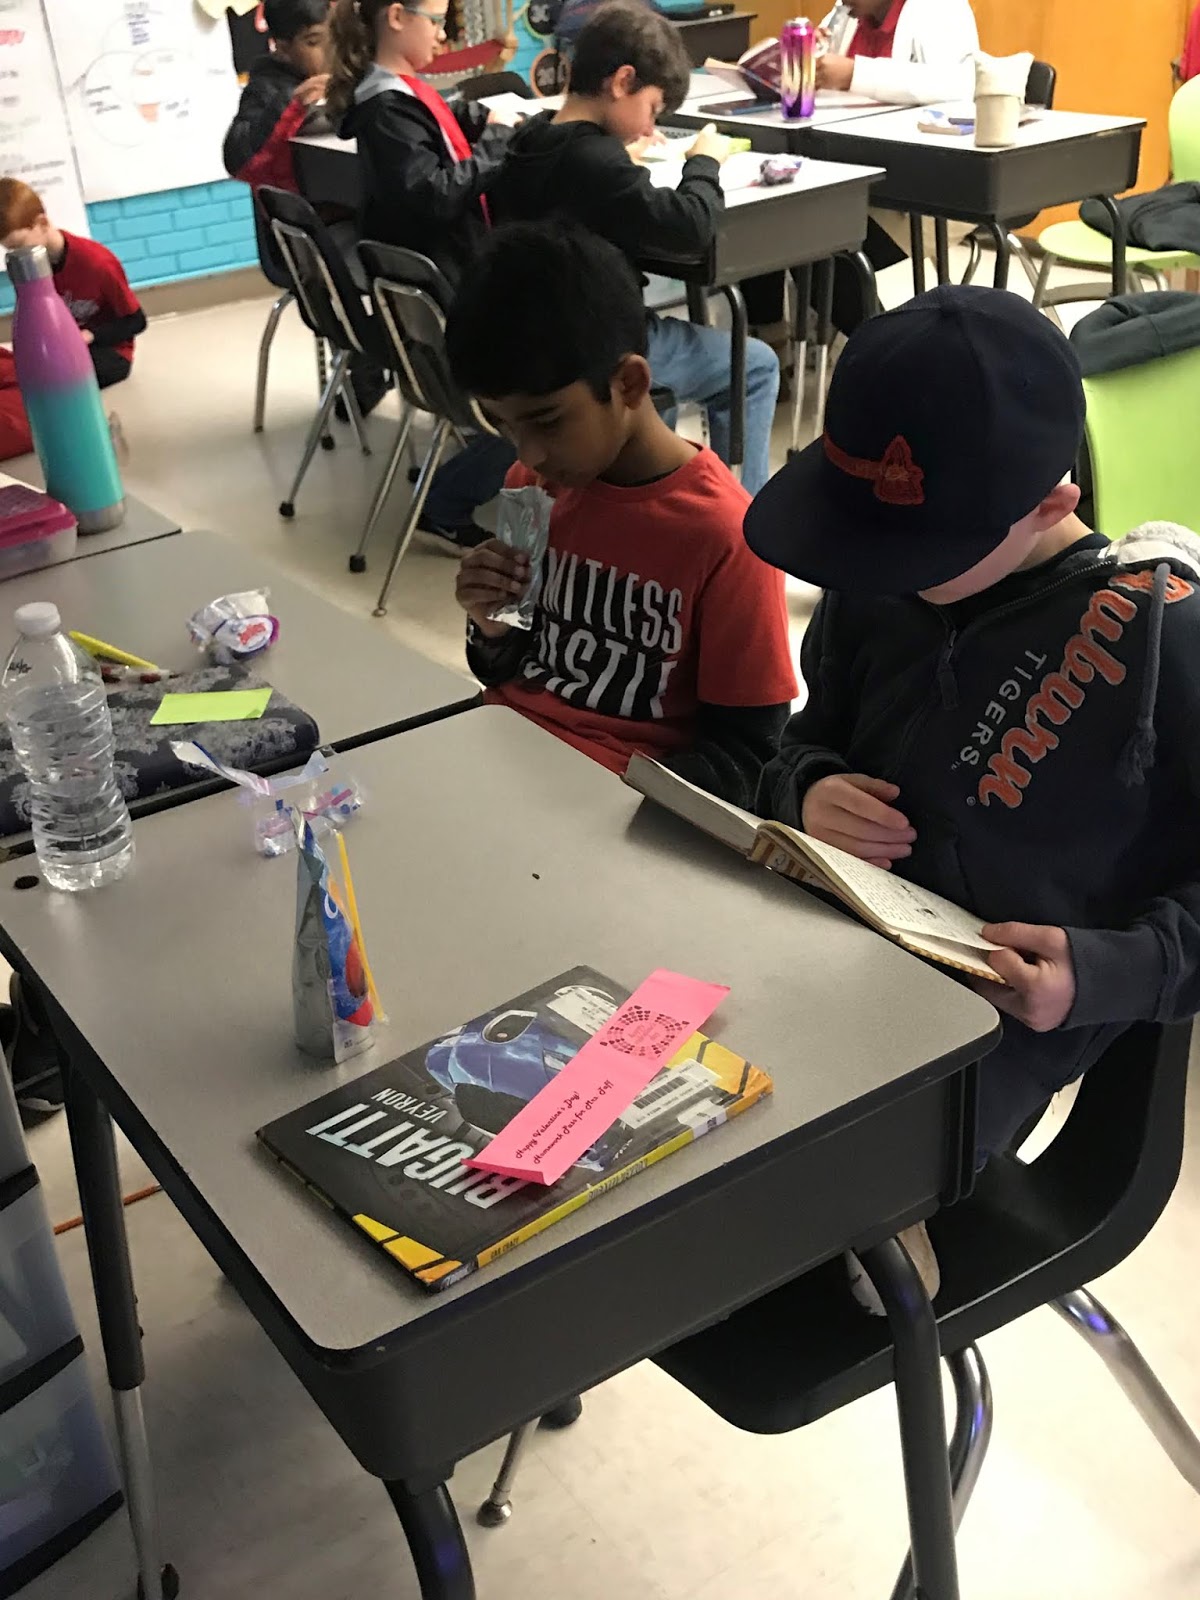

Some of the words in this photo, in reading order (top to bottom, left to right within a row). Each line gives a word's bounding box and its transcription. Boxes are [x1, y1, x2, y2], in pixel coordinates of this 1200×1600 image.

[543, 546, 683, 654] MITLESS
[959, 650, 1047, 767] TIGERS
[370, 1087, 449, 1124] VEYRON
[515, 1138, 538, 1159] Happy
[532, 1106, 566, 1138] Valentine's
[533, 1133, 564, 1165] Homework
[563, 1118, 578, 1135] Pass
[574, 1109, 586, 1121] for
